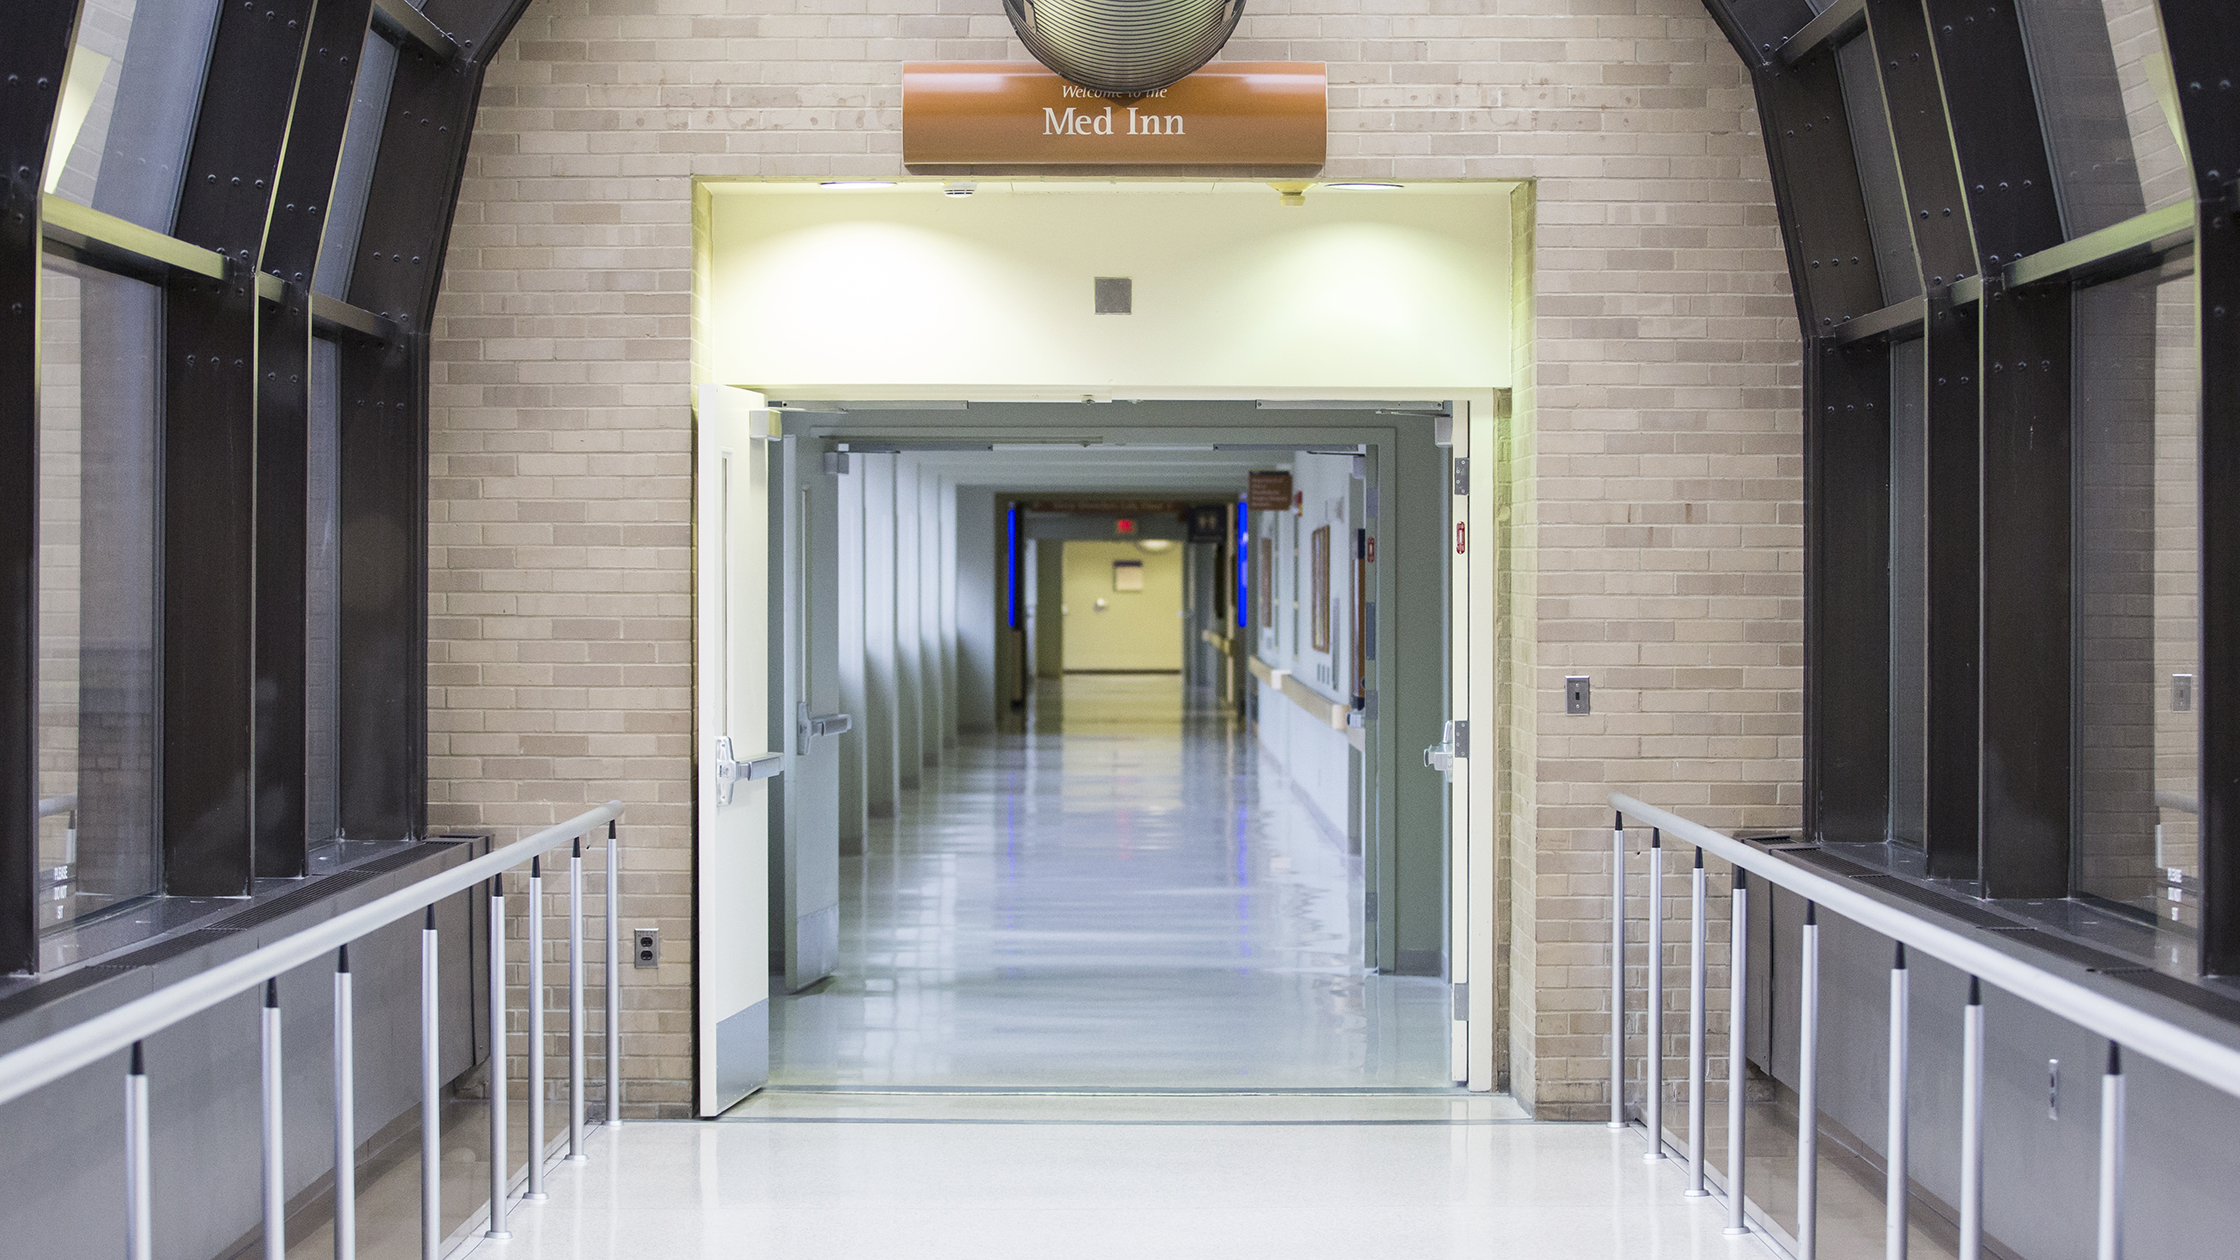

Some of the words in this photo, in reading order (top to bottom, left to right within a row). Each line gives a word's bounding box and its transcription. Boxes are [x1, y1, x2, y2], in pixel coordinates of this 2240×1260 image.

[1042, 106, 1114, 135] Med
[1126, 107, 1186, 135] Inn
[54, 865, 68, 880] PLEASE
